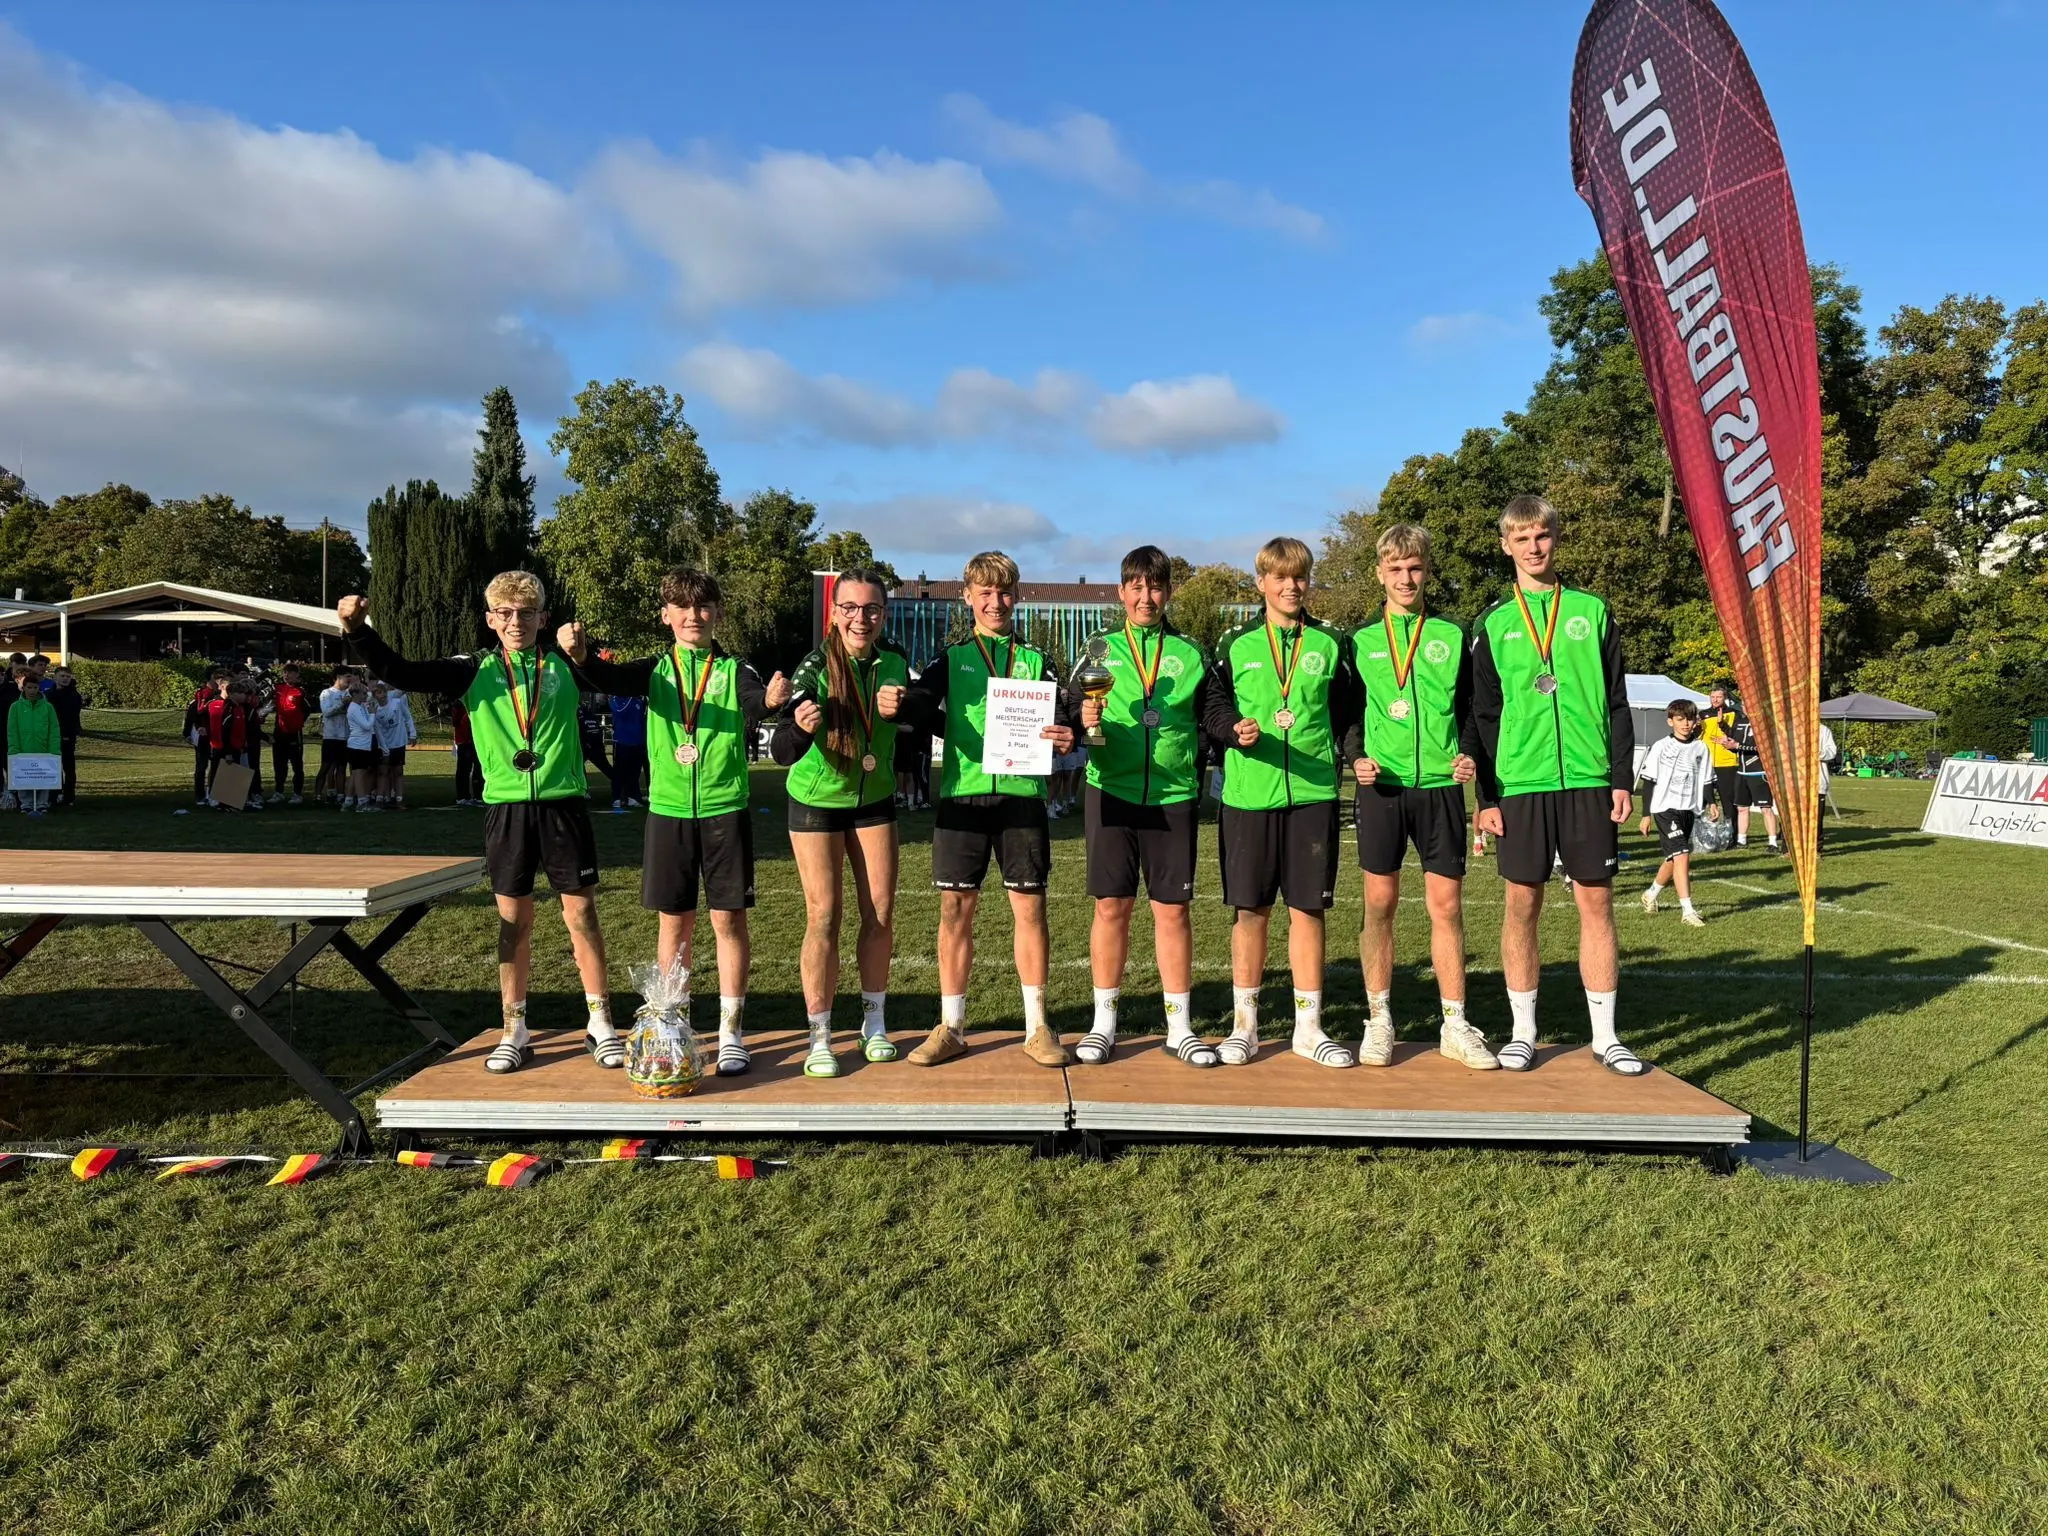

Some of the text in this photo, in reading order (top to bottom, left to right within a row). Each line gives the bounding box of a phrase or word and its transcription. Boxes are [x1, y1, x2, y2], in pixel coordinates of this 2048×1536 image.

[960, 664, 975, 673] AKO
[993, 688, 1051, 701] URKUNDE
[1004, 706, 1036, 715] DEUTSCHE
[995, 714, 1045, 724] MEISTERSCHAFT
[1014, 741, 1029, 749] Platz
[1969, 803, 2046, 837] Logistic
